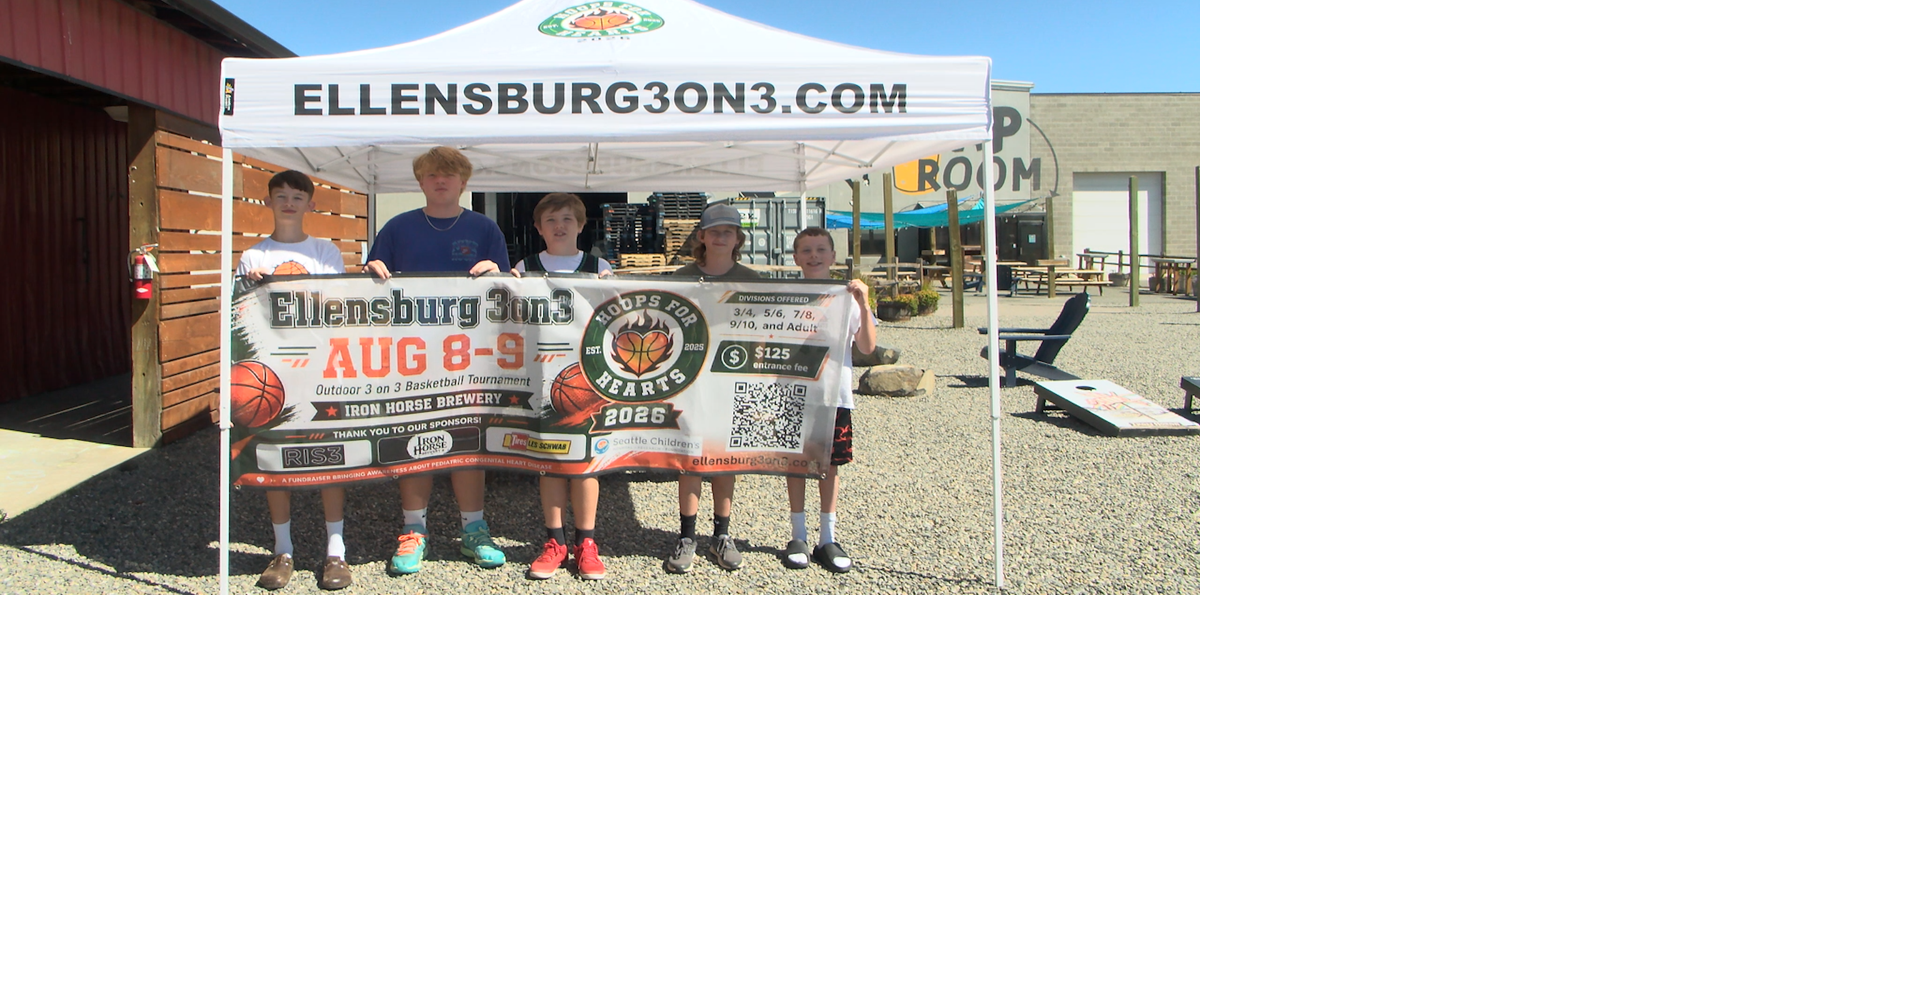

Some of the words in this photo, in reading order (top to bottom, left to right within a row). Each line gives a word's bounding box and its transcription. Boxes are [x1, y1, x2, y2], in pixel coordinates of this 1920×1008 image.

[293, 81, 908, 116] ELLENSBURG3ON3.COM
[917, 156, 1041, 193] ROOM
[269, 287, 481, 329] Ellensburg
[485, 286, 575, 326] 3on3
[738, 295, 775, 303] DIVISIONS
[776, 295, 810, 304] OFFERED
[595, 295, 661, 326] HOOPS
[665, 300, 698, 327] FOR
[733, 307, 756, 318] 3/4,
[763, 308, 786, 319] 5/6,
[793, 309, 815, 321] 7/8,
[729, 320, 758, 331] 9/10,
[762, 321, 784, 330] and
[786, 322, 818, 333] Adult
[323, 336, 427, 378] AUG
[442, 332, 525, 371] 8-9
[586, 346, 602, 355] EST.
[754, 346, 790, 360] $125
[753, 362, 792, 372] entrance
[794, 363, 808, 372] fee
[316, 384, 361, 397] Outdoor
[365, 384, 372, 394] 3
[376, 385, 390, 394] on
[394, 382, 401, 392] 3
[405, 375, 464, 391] Basketball
[467, 373, 531, 387] Tournament
[595, 369, 686, 396] HEARTS
[344, 402, 382, 418] IRON
[385, 398, 432, 414] HORSE
[436, 393, 503, 410] BREWERY
[604, 406, 665, 426] 2026
[333, 429, 369, 439] THANK
[370, 428, 390, 436] YOU
[392, 425, 405, 434] TO
[407, 423, 427, 431] OUR
[429, 417, 482, 429] SPONSORS!
[413, 441, 448, 456] HORSE
[417, 435, 445, 447] IRON
[539, 441, 568, 450] SCHWAB
[613, 437, 647, 446] Seattle
[650, 437, 700, 449] Children's
[284, 446, 343, 465] RIS3
[288, 475, 331, 483] FUNDRAISER
[332, 472, 365, 480] BRINGING
[367, 467, 407, 476] AWARENESS
[408, 463, 430, 471] ABOUT
[431, 458, 463, 468] PEDIATRIC
[527, 462, 552, 470] DISEASE
